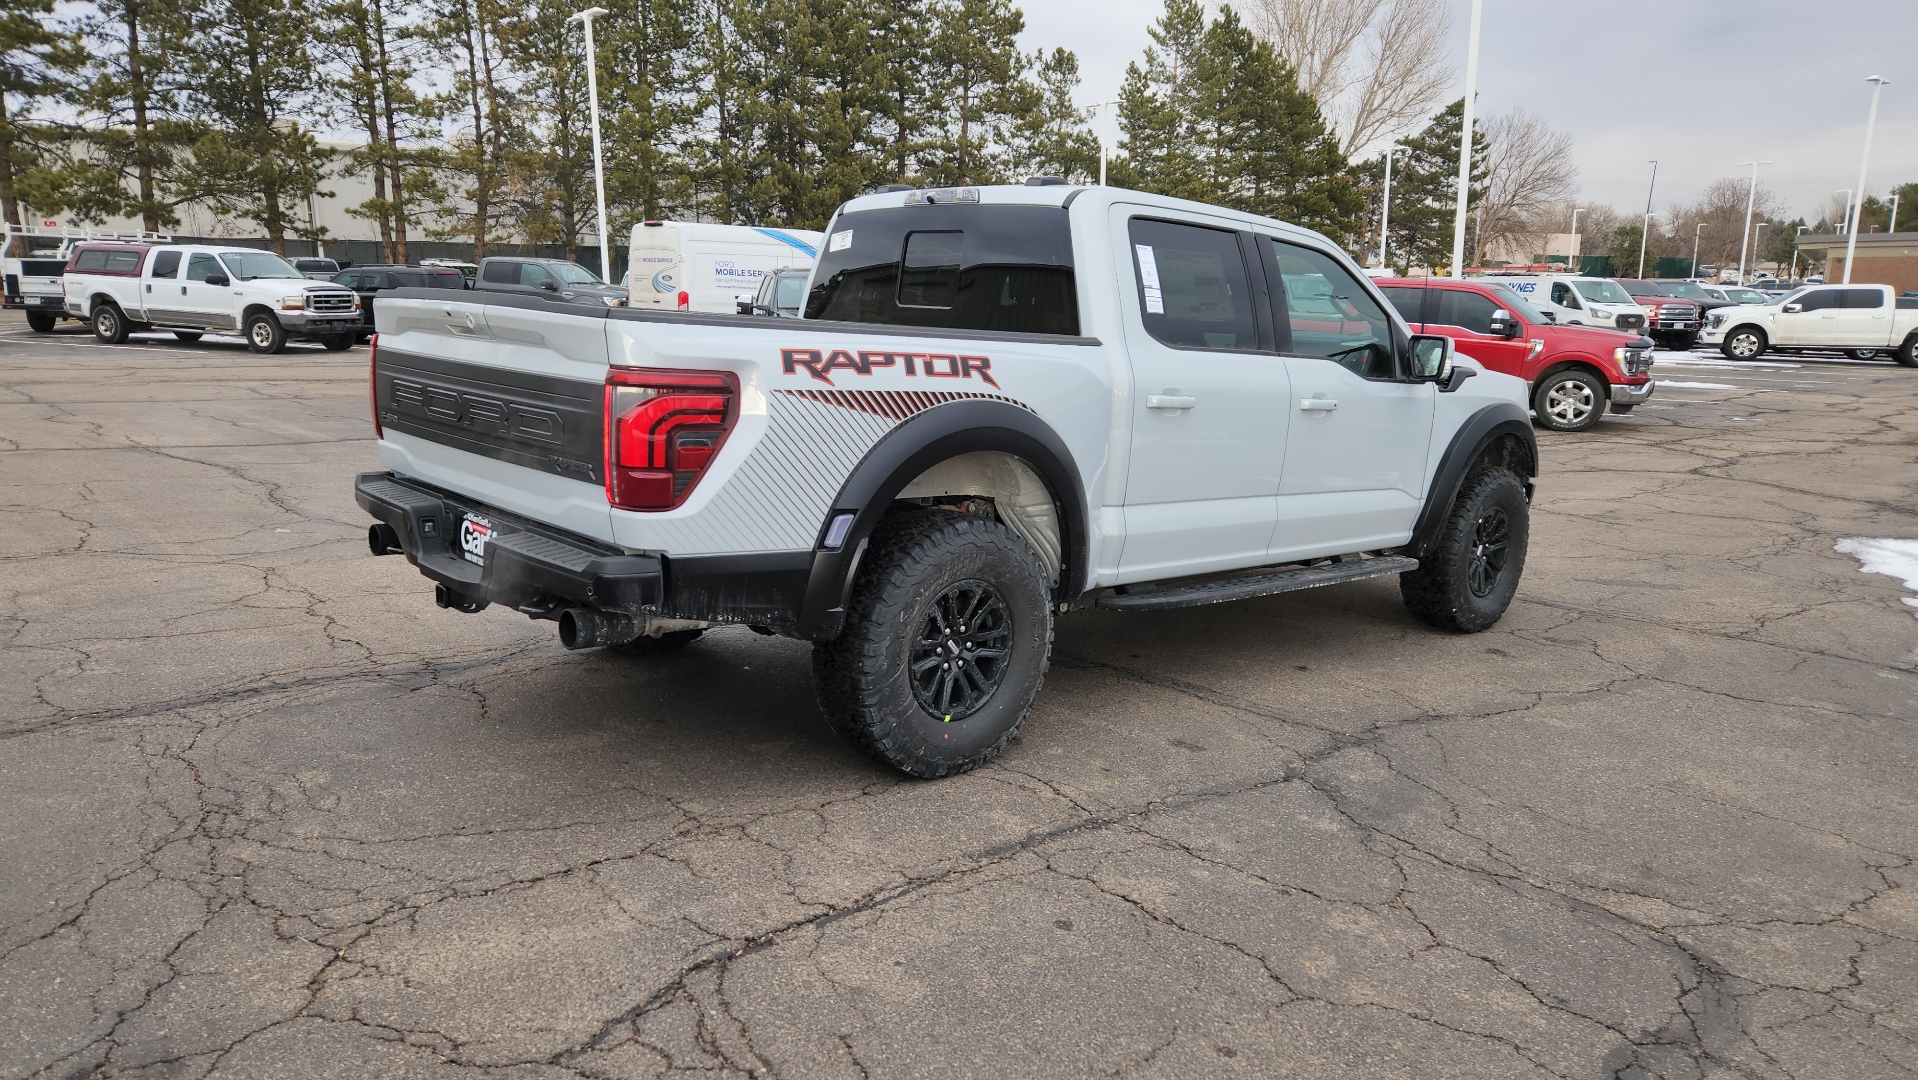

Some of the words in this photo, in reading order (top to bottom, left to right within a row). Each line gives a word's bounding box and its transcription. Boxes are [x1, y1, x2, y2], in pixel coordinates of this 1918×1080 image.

[715, 260, 734, 268] FORD
[715, 268, 746, 276] MOBILE
[747, 269, 767, 277] SERV
[780, 348, 1001, 391] RAPTOR
[391, 378, 564, 447] FORD
[548, 454, 597, 481] RAPTOR
